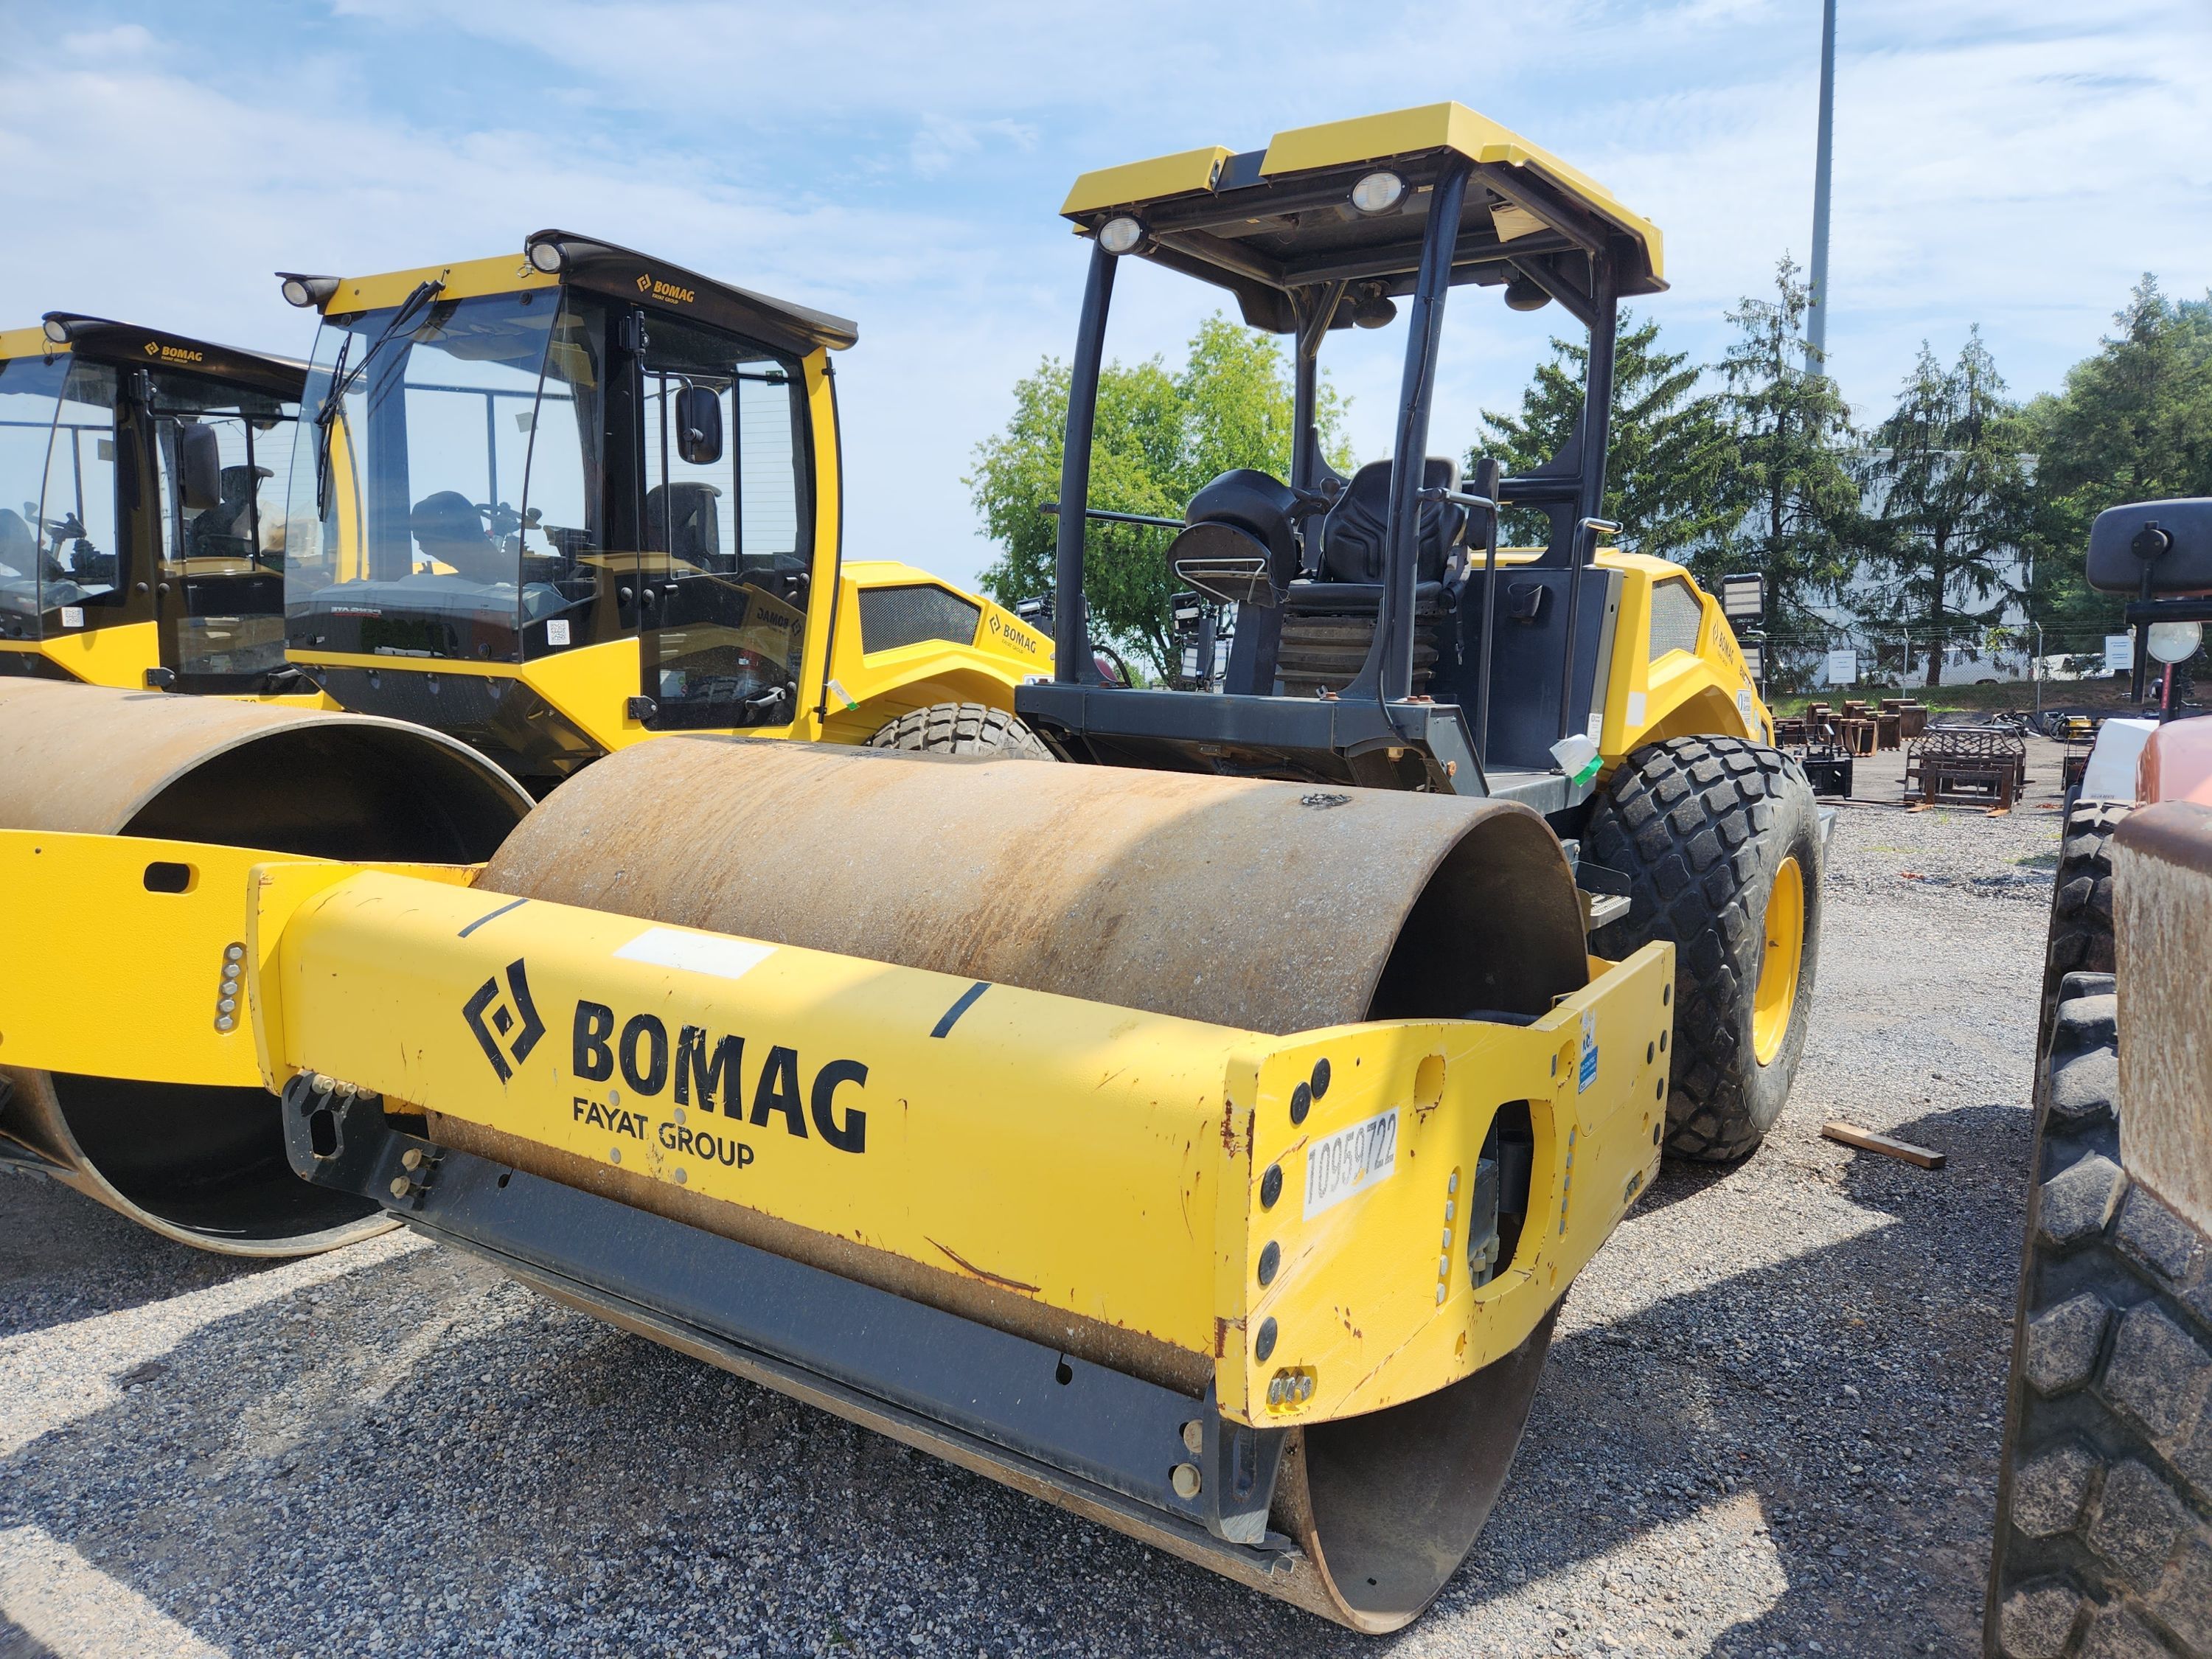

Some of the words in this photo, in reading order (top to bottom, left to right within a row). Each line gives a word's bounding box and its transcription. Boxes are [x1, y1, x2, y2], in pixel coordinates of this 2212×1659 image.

[653, 280, 695, 303] BOMAG
[162, 346, 203, 362] BOMAG
[1003, 624, 1037, 654] BOMAG
[1719, 631, 1734, 665] BOMAG
[572, 999, 869, 1154] BOMAG
[573, 1096, 649, 1140] FAYAT
[658, 1121, 755, 1169] GROUP
[1307, 1112, 1397, 1205] 10959722
